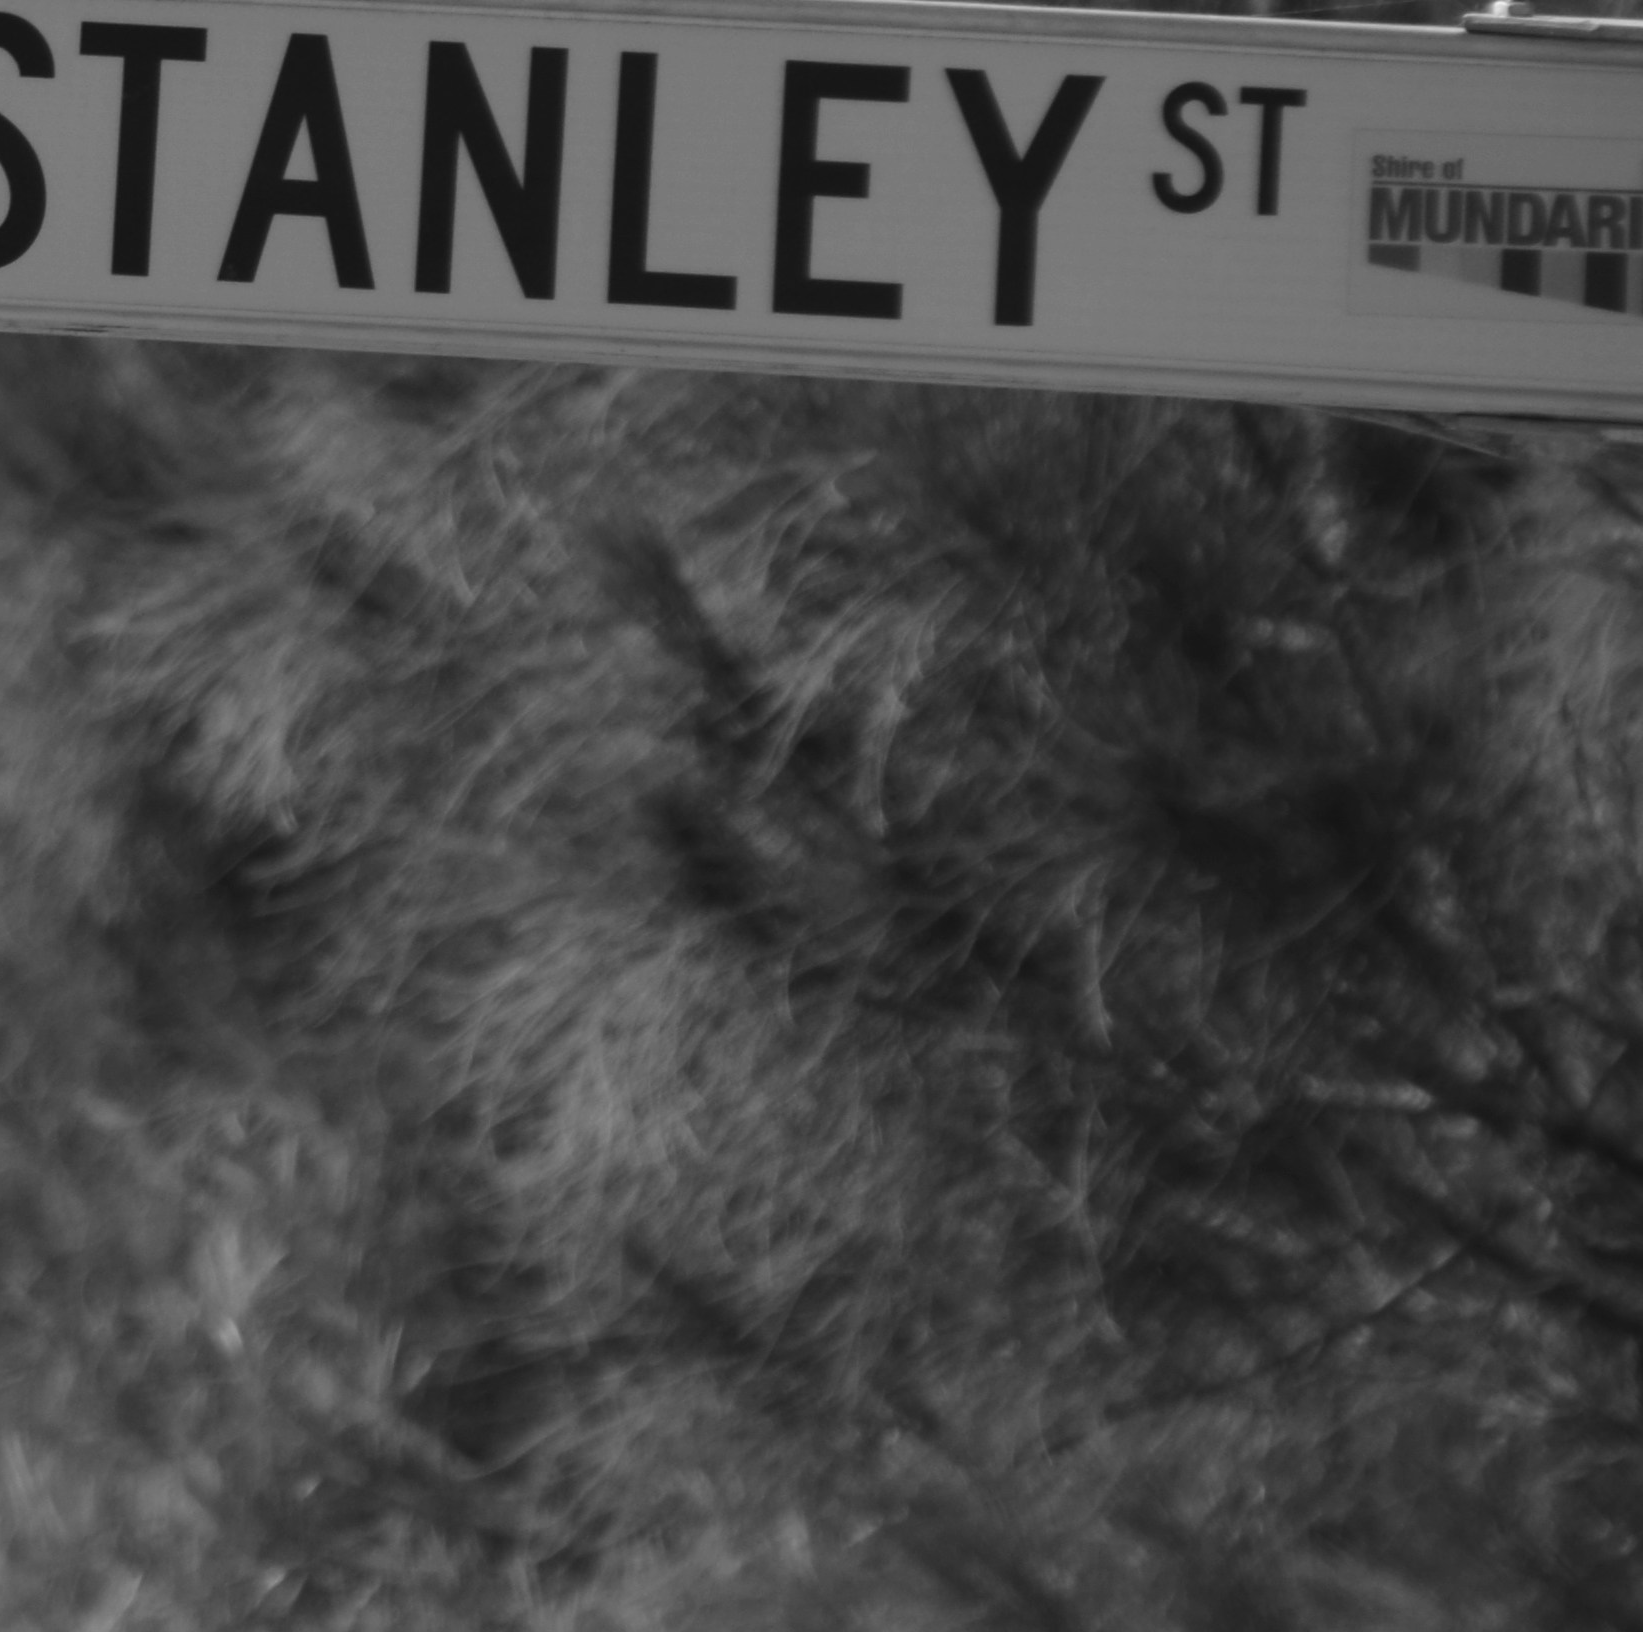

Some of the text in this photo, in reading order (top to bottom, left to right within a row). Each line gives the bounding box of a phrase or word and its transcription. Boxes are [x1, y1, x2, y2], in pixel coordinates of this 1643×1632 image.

[1151, 80, 1308, 217] ST
[1372, 154, 1464, 180] Shire of
